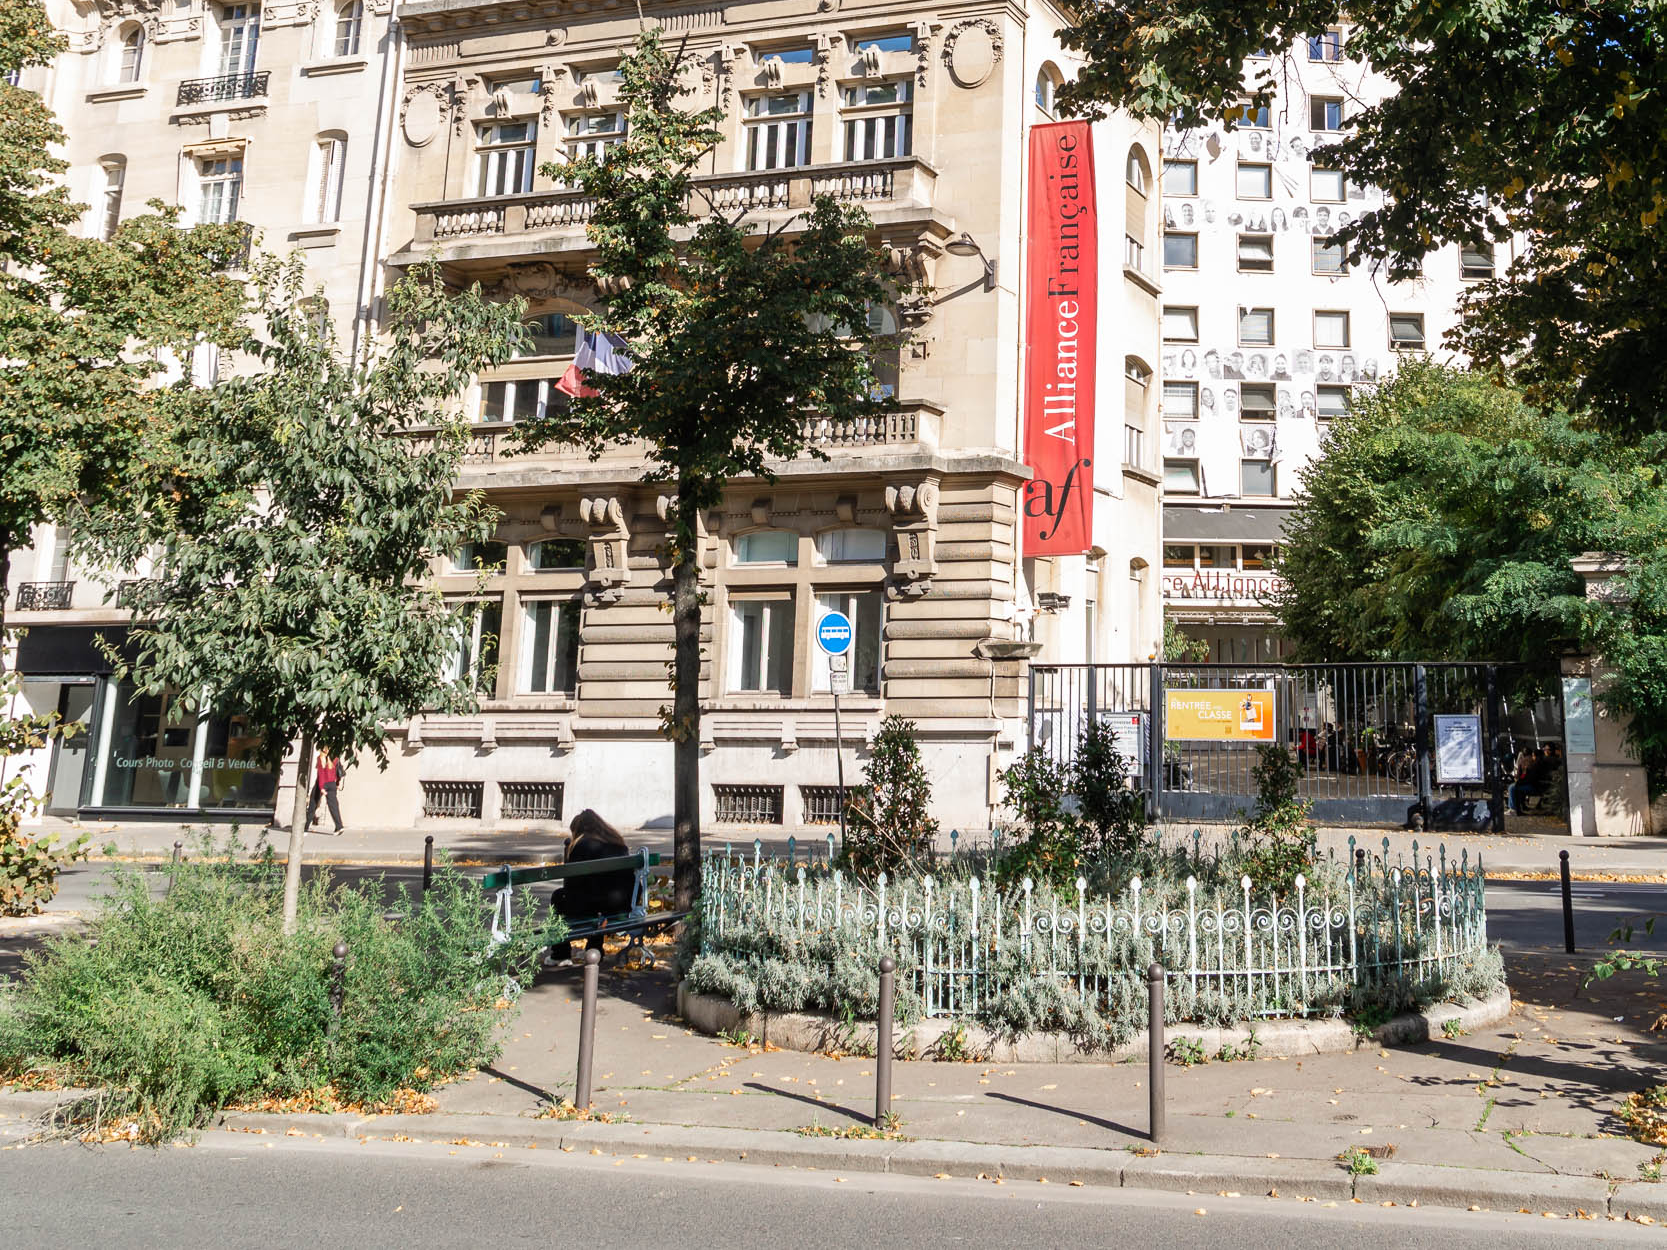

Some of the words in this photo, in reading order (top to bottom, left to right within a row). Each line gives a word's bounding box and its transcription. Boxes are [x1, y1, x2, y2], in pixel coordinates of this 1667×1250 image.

[1024, 458, 1091, 540] af
[1192, 569, 1281, 593] Alliance
[1198, 710, 1233, 719] CLASSE
[116, 757, 143, 768] Cours
[145, 756, 174, 768] Photo
[217, 757, 225, 769] &
[228, 758, 257, 769] Vente
